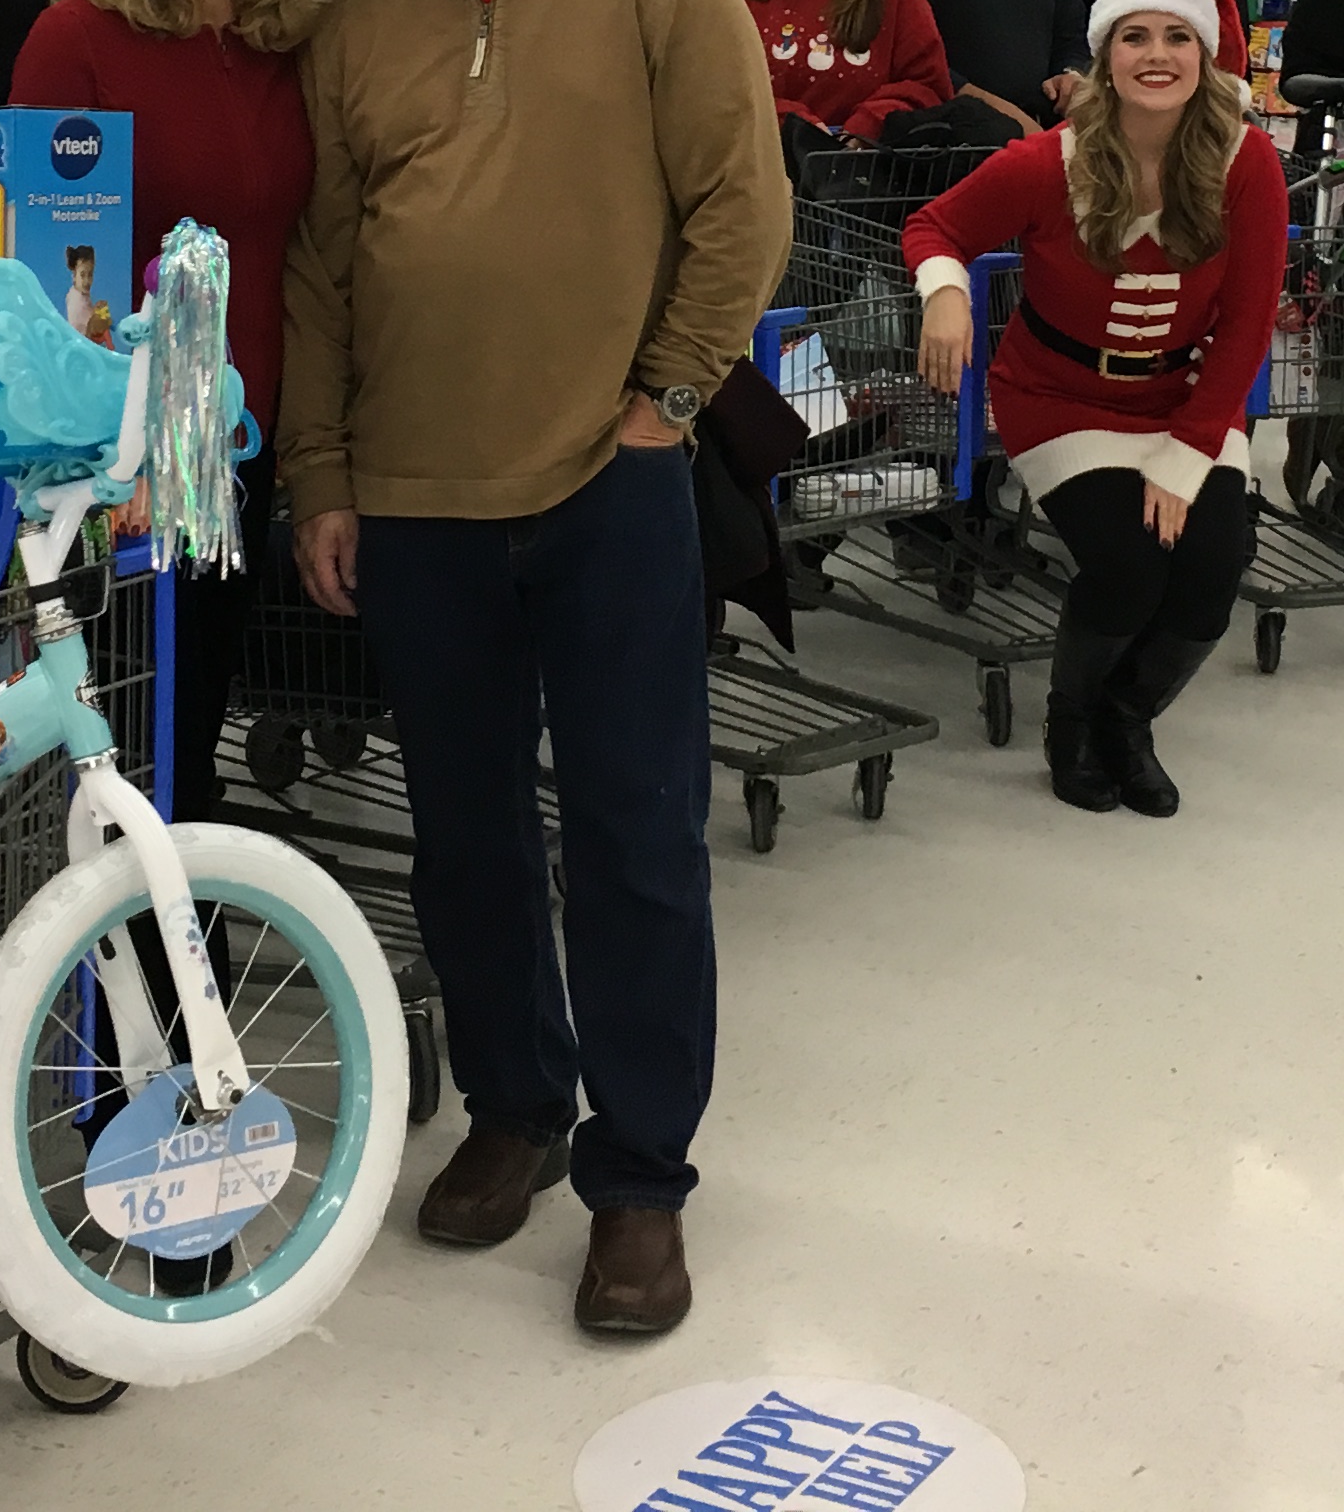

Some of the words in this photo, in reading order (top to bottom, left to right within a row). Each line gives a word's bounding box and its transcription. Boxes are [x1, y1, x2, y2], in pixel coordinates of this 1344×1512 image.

[53, 136, 99, 156] vtech
[57, 193, 85, 206] Learn
[86, 193, 94, 205] &
[94, 193, 122, 205] Zoom
[51, 209, 100, 222] Motorbike
[157, 1123, 227, 1165] KIDS
